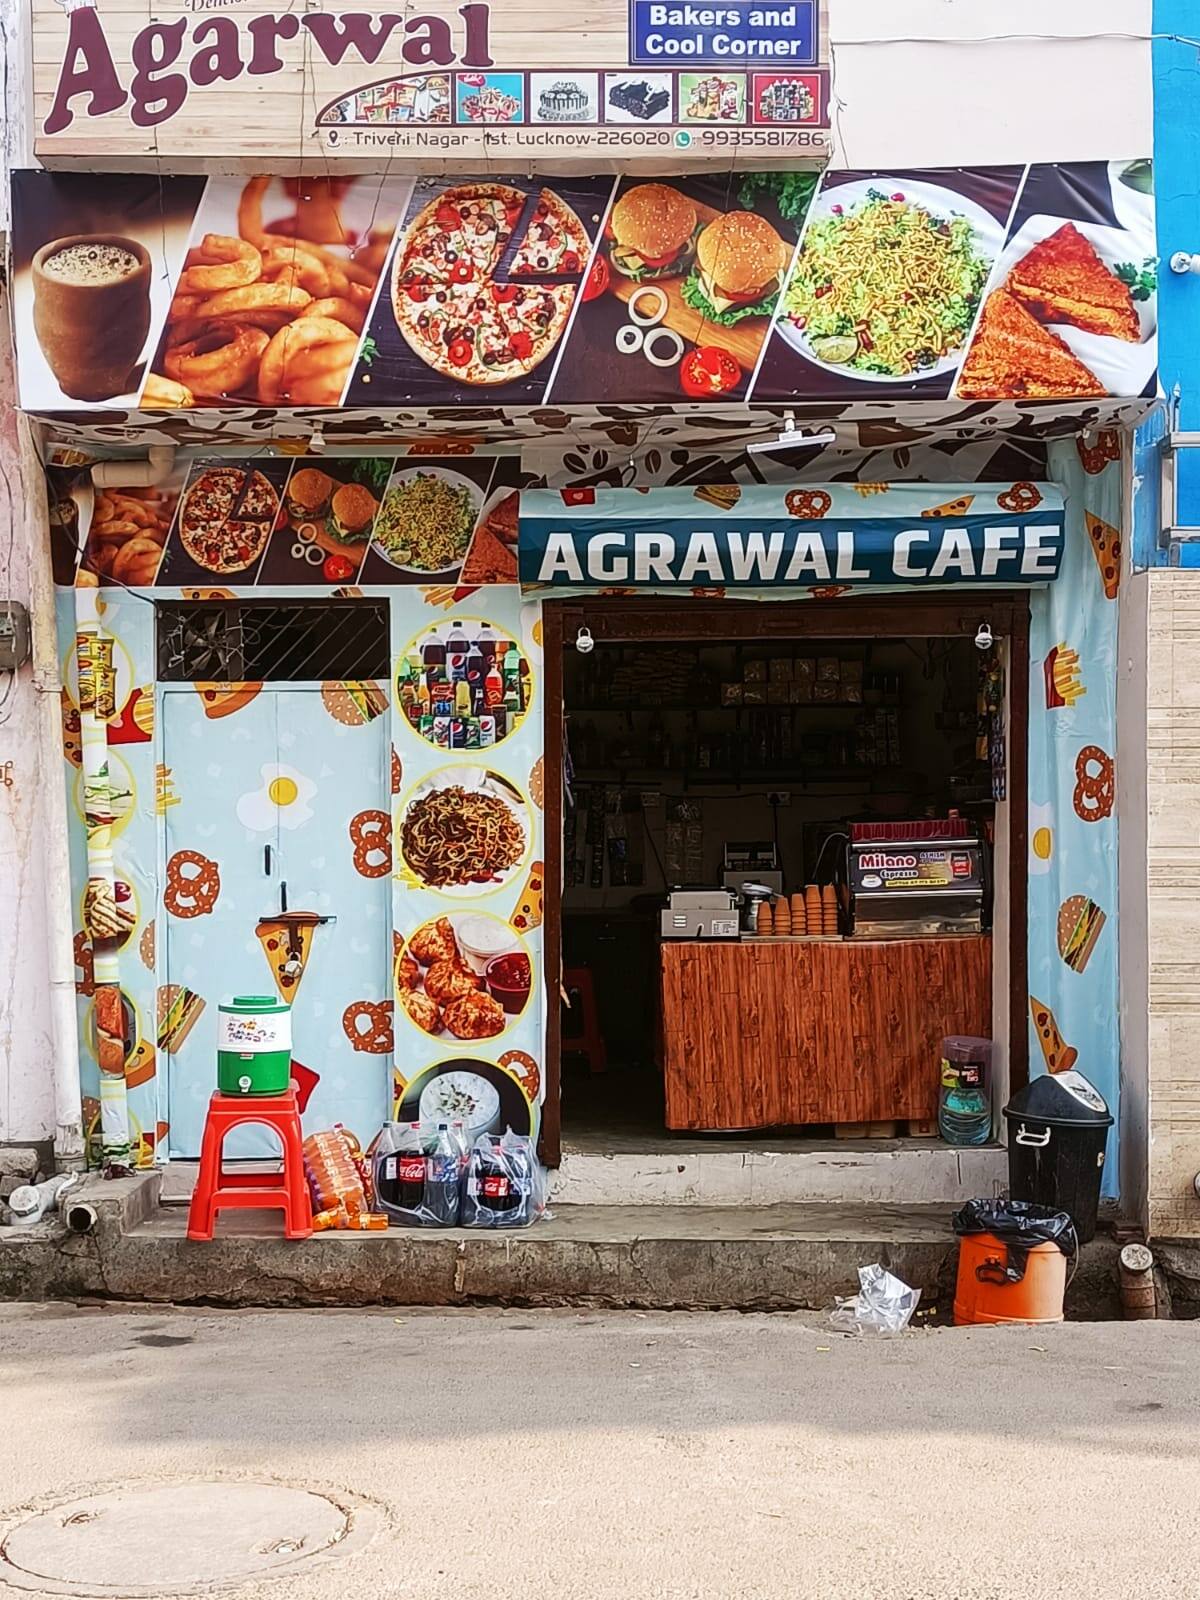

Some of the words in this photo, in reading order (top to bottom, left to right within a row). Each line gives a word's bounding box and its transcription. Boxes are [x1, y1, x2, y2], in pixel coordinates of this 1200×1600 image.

[649, 5, 741, 27] Bakers
[748, 6, 797, 27] and
[645, 34, 703, 56] Cool
[711, 34, 802, 56] Corner
[43, 3, 495, 136] Agarwal
[416, 131, 469, 149] Nagar
[516, 130, 671, 147] Lucknow-226020
[702, 130, 825, 147] 9935581786
[537, 531, 871, 582] AGRAWAL
[891, 524, 1062, 578] CAFE
[859, 853, 917, 870] Milano
[880, 869, 919, 880] Espresso
